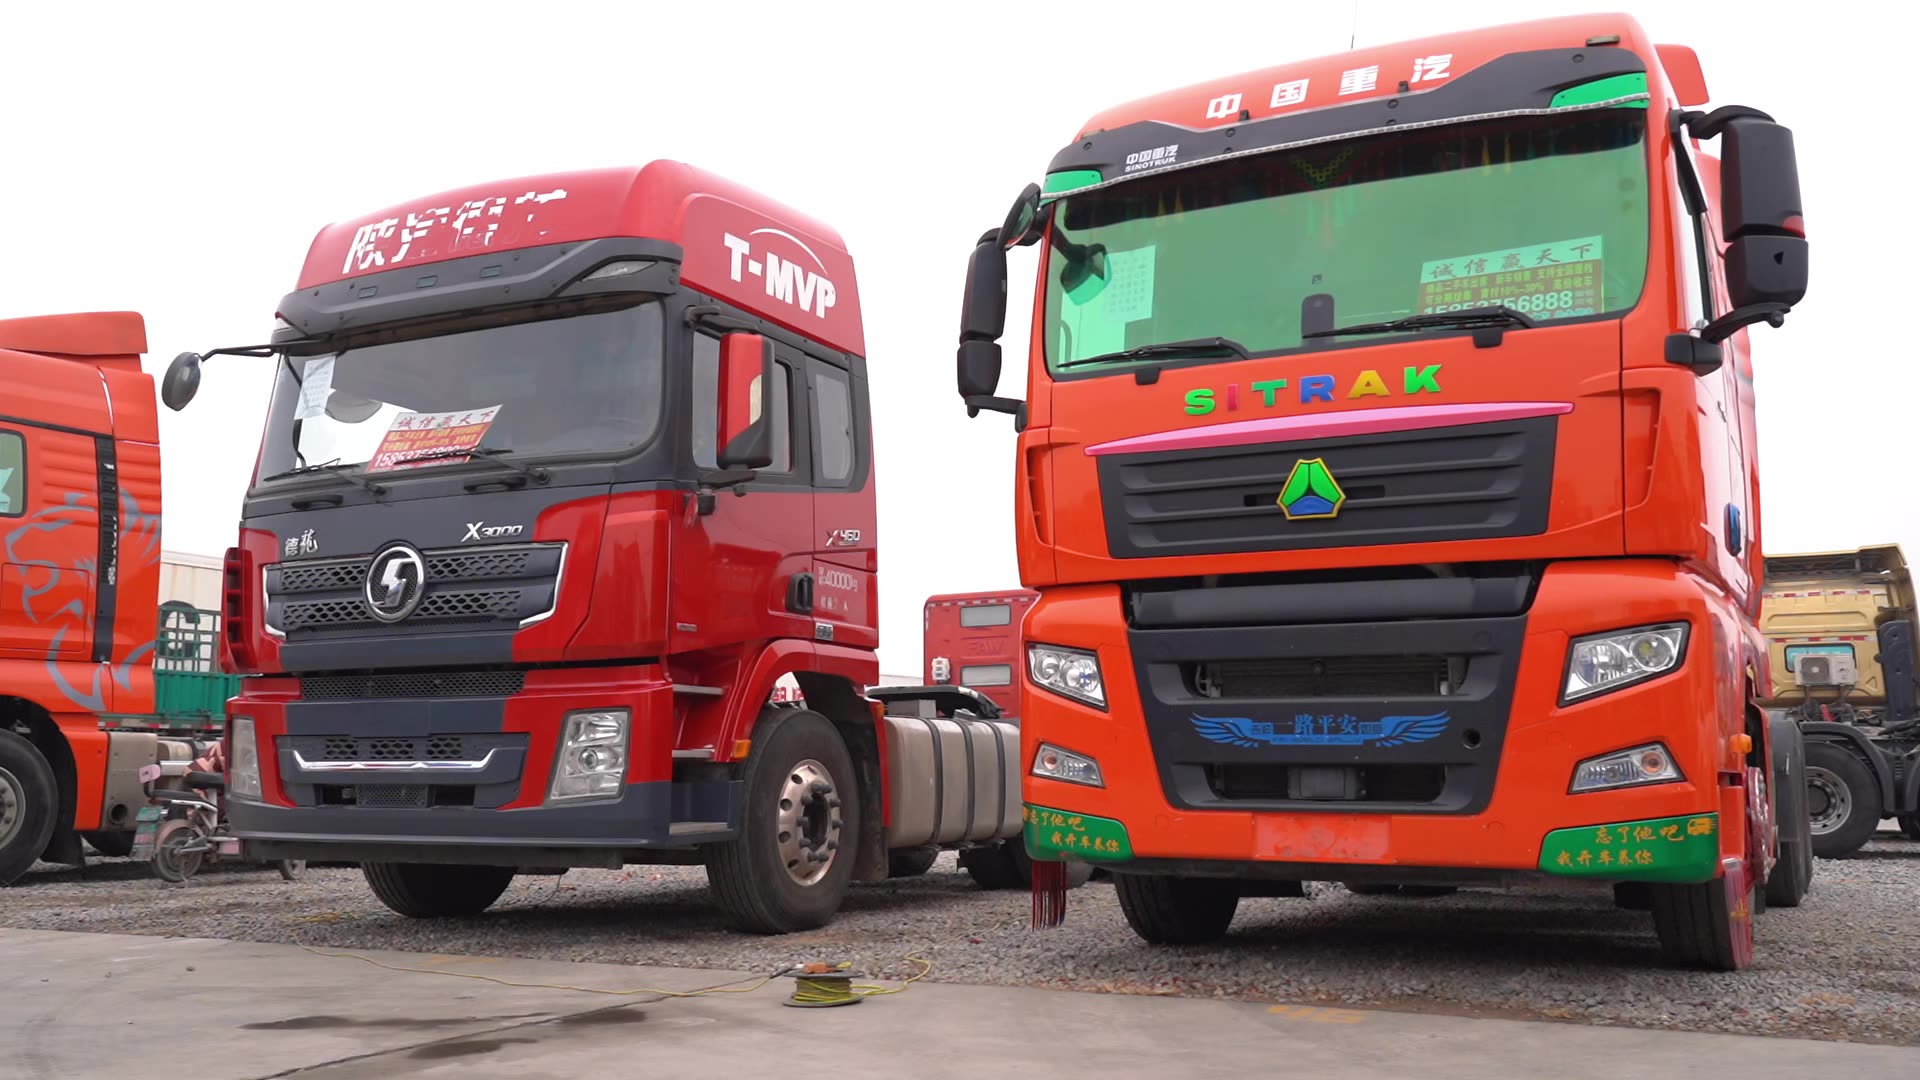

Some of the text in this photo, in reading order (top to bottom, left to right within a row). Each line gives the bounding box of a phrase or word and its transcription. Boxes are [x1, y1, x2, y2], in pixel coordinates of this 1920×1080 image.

[1206, 54, 1453, 119] 中国重汽
[1125, 156, 1176, 172] SINOTRUK
[1126, 144, 1179, 165] 中国重汽
[723, 231, 837, 319] T-MVP
[1429, 243, 1594, 279] 诚信赢天下
[1184, 364, 1442, 416] SITRAK
[461, 521, 523, 542] X3000
